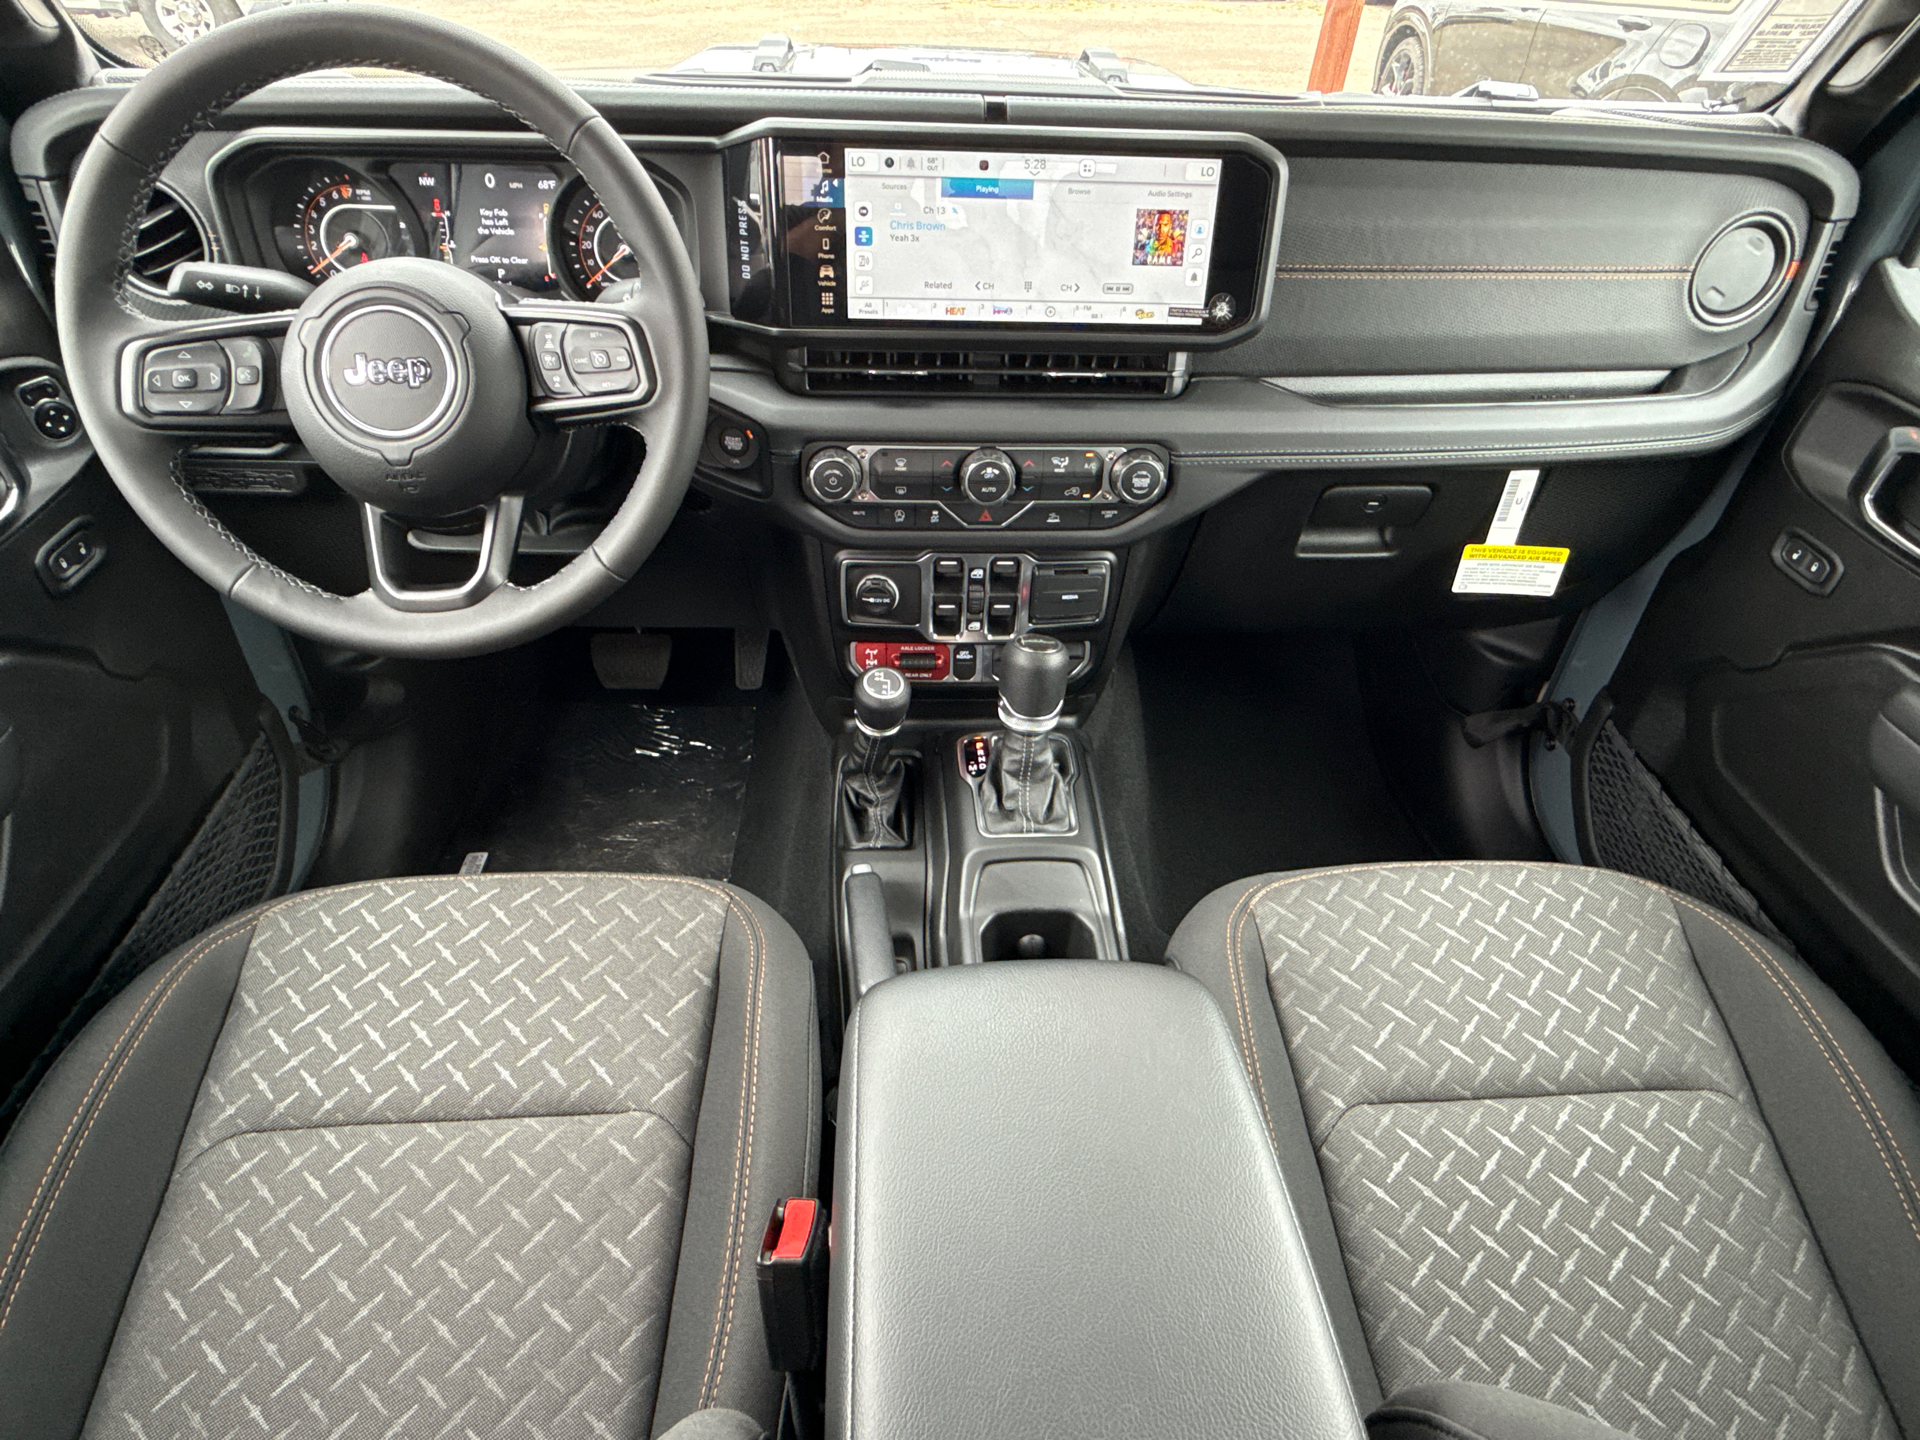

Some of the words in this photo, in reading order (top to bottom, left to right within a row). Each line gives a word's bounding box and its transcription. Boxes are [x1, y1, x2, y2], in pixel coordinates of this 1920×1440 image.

[851, 156, 866, 167] LO
[1024, 159, 1046, 170] 5:28
[1200, 166, 1215, 177] LO
[418, 176, 434, 186] NW
[881, 182, 908, 190] Sources
[975, 184, 999, 194] Playing
[1068, 188, 1091, 196] Browse
[332, 190, 339, 200] 6
[1148, 190, 1166, 198] Audio
[1167, 190, 1192, 200] Settings
[319, 197, 326, 207] 5
[480, 208, 493, 218] Key
[494, 208, 508, 217] Fob
[592, 210, 604, 219] 40
[923, 206, 934, 214] Ch
[936, 206, 946, 215] 13
[482, 218, 494, 226] has
[495, 218, 508, 226] Left
[737, 200, 748, 236] PRESS
[890, 220, 914, 230] Chris
[916, 220, 946, 231] Brown
[478, 227, 490, 235] the
[490, 227, 515, 236] Vehicle
[890, 234, 909, 242] Yeah
[910, 234, 920, 242] 3x
[581, 240, 592, 250] 20
[740, 240, 750, 261] NOT
[470, 255, 489, 263] Press
[510, 256, 528, 264] Clear
[497, 268, 506, 278] P
[742, 264, 751, 280] DO
[924, 281, 953, 289] Related
[945, 307, 966, 316] HEAT
[342, 352, 432, 389] Jeep
[177, 374, 191, 382] OK
[975, 741, 984, 750] P
